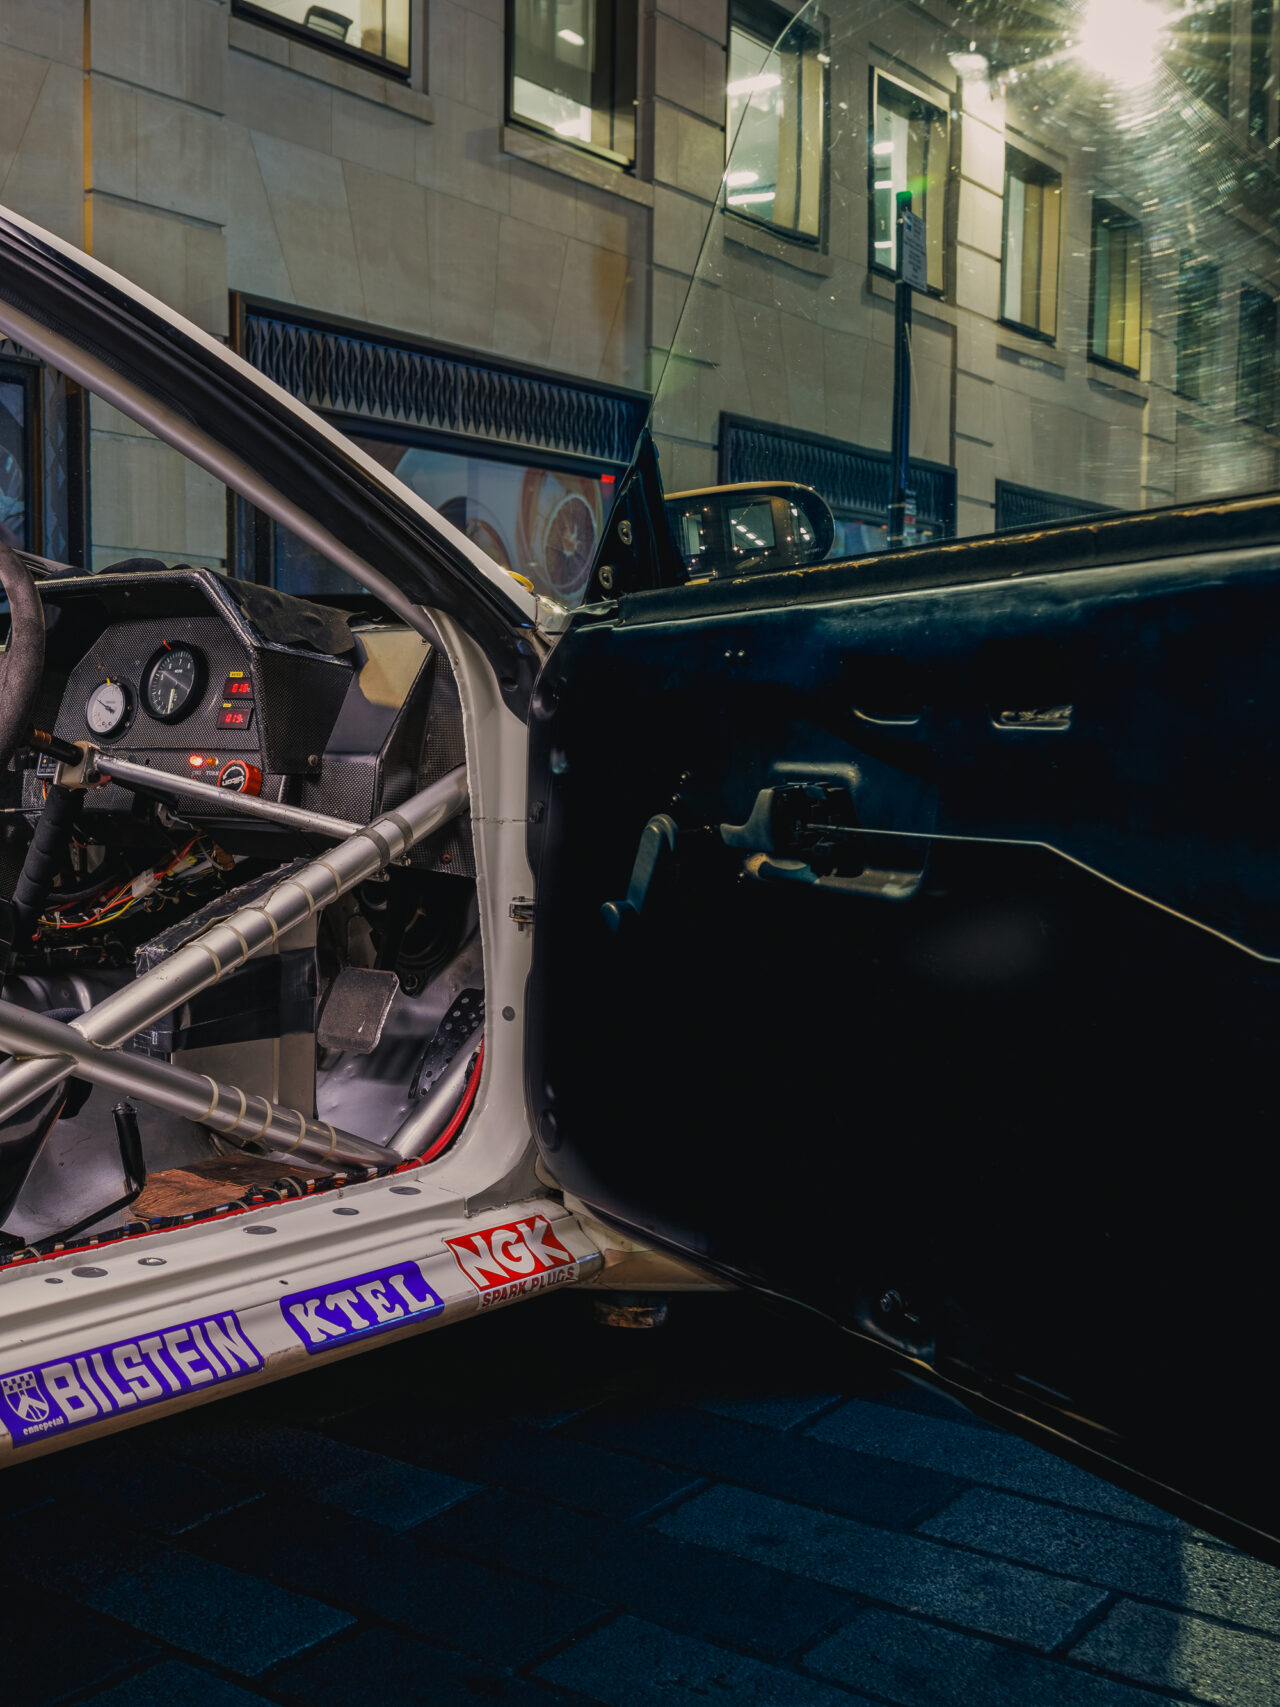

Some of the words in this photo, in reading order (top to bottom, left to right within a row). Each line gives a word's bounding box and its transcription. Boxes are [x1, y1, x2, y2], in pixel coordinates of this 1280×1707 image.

[451, 1222, 570, 1287] NGK
[482, 1280, 528, 1307] SPARK
[531, 1266, 575, 1292] PLUGS
[289, 1275, 435, 1343] KTEL
[41, 1315, 259, 1424] BILSTEIN
[23, 1416, 65, 1435] ennepetal
